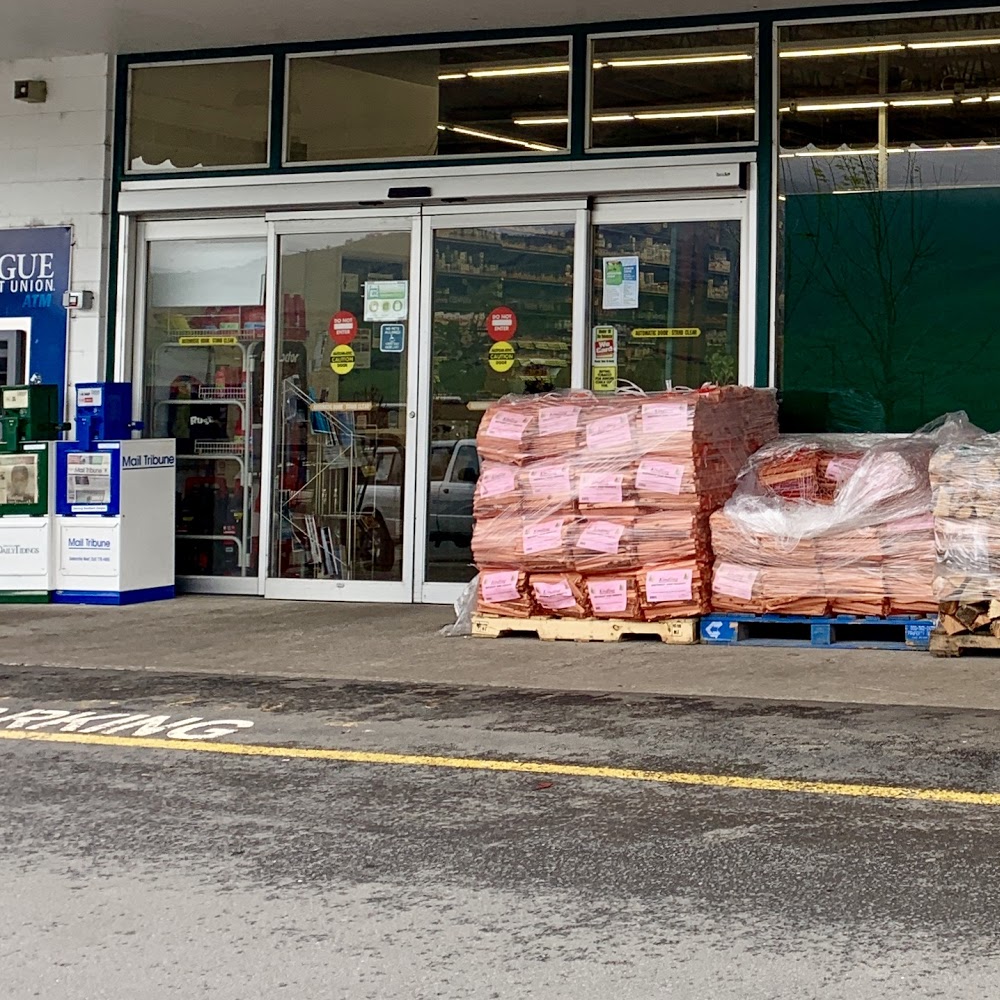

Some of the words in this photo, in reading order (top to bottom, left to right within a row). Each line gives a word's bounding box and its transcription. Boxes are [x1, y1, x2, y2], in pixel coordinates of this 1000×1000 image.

[0, 253, 54, 280] GUE
[10, 279, 54, 293] UNION
[22, 293, 52, 308] ATM
[122, 455, 141, 467] Mail
[143, 455, 175, 466] Tribune
[68, 538, 83, 547] Mail
[85, 538, 111, 547] Tribune
[0, 707, 254, 740] RKING
